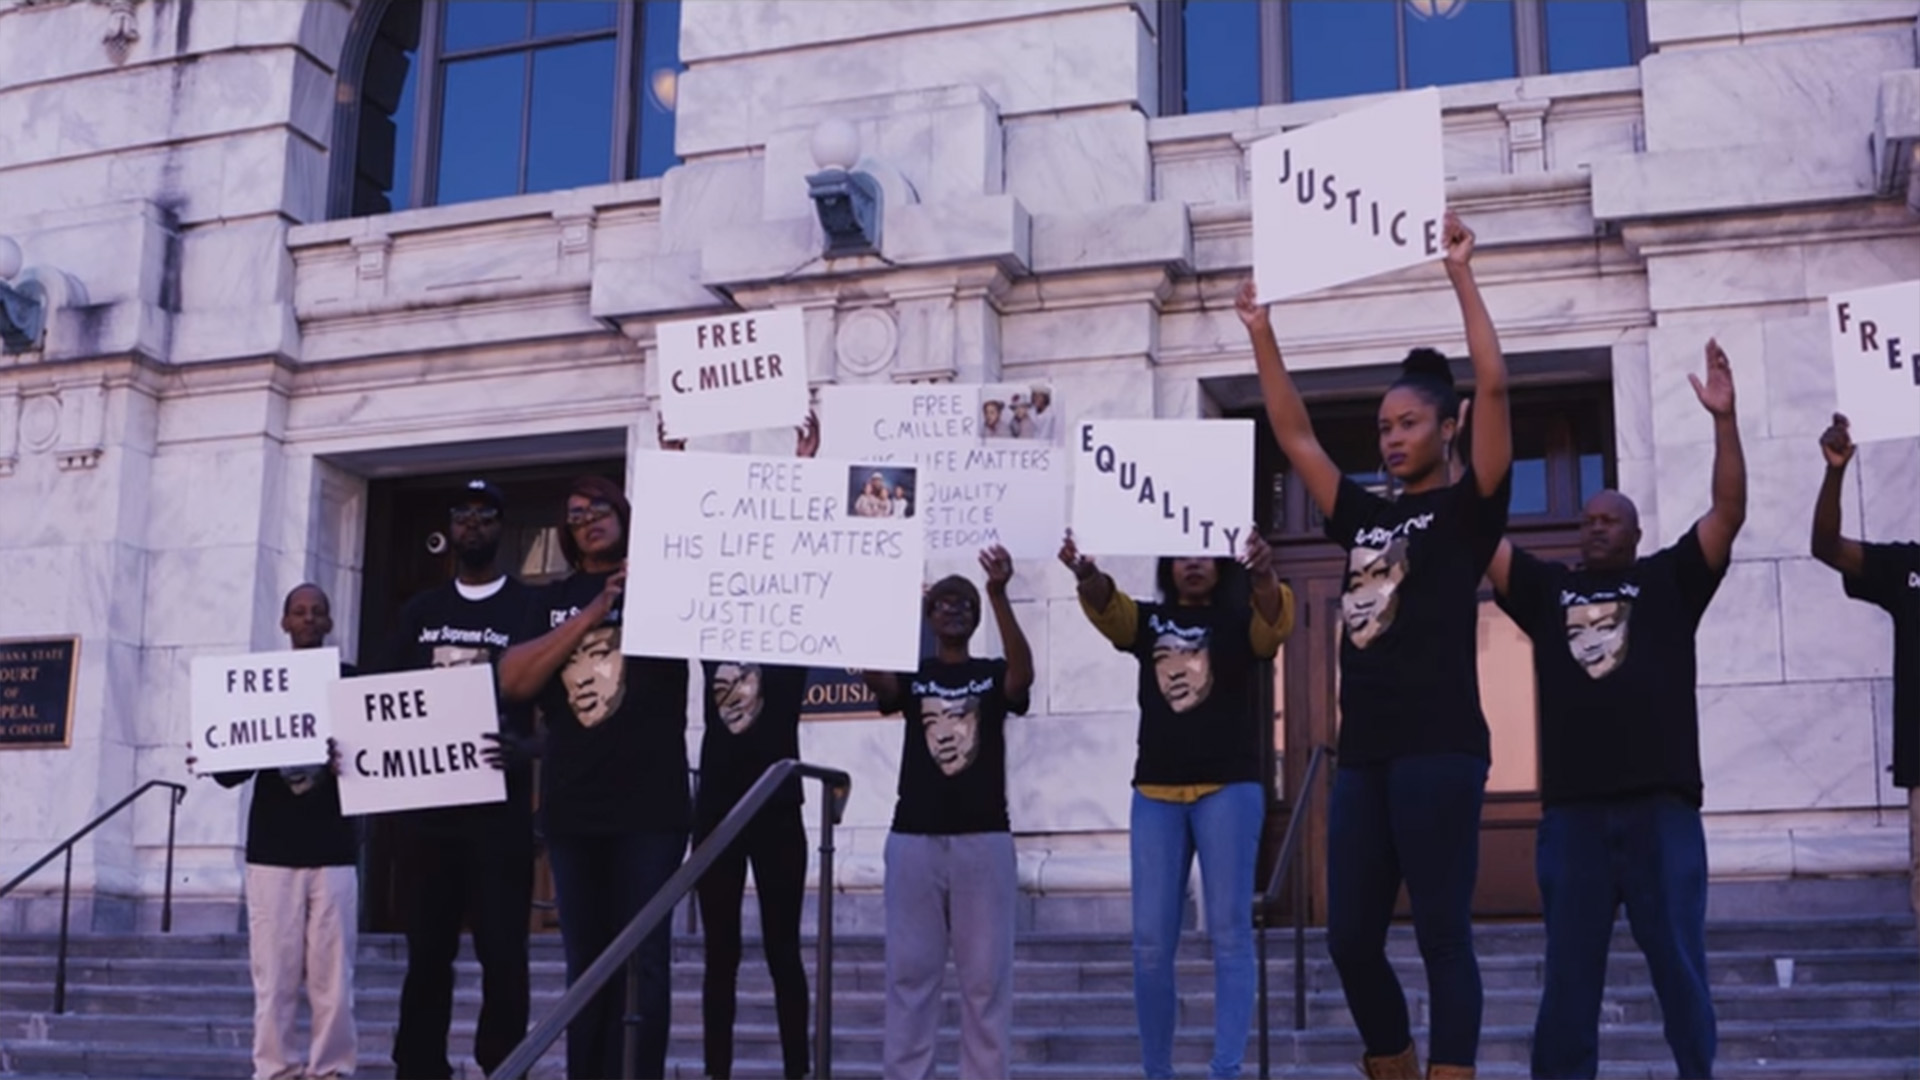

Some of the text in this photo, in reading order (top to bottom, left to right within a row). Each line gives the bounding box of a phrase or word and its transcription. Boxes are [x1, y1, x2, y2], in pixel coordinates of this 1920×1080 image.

[1279, 148, 1438, 256] JUSTICE
[697, 319, 756, 349] FREE
[913, 394, 963, 416] FREE
[964, 449, 1051, 471] MATTERS
[748, 461, 803, 493] FREE
[1082, 424, 1240, 556] EQUALITY
[924, 505, 994, 525] STICE
[663, 530, 903, 560] HIS LIFE MATTERS
[923, 527, 1001, 549] EEDOM
[709, 571, 833, 599] EQUALITY
[679, 598, 804, 628] JUSTICE
[699, 627, 842, 655] FREEDOM
[227, 667, 289, 693] FREE
[364, 689, 428, 723] FREE
[802, 683, 877, 706] OUISI
